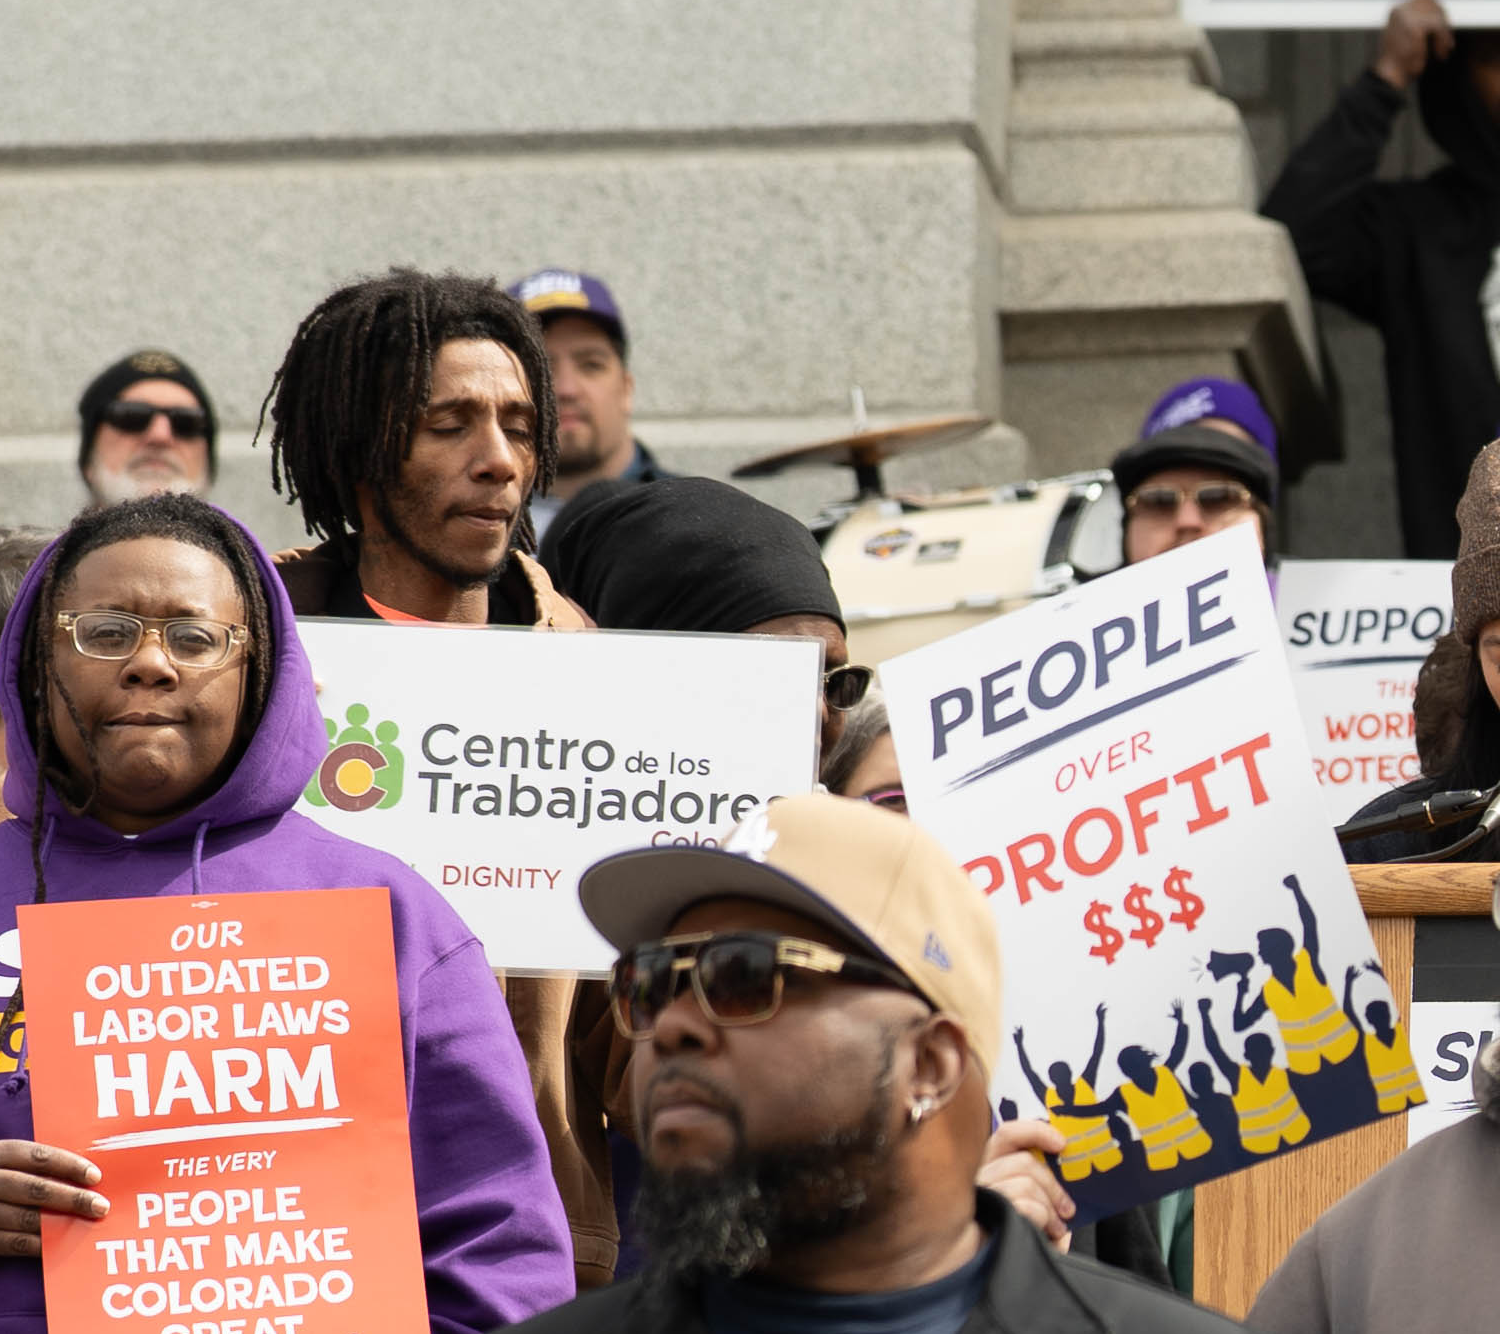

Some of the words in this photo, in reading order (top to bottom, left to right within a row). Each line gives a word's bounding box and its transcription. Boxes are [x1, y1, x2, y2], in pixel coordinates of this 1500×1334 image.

[1288, 606, 1455, 647] SUPPO
[931, 570, 1237, 760] PEOPLE
[419, 723, 615, 773] Centro
[625, 749, 657, 774] de
[669, 749, 711, 776] los
[1324, 712, 1415, 742] WOR
[1055, 730, 1153, 793] OVER
[418, 771, 788, 827] Trabajadore
[443, 865, 562, 890] DIGNITY
[171, 919, 244, 953] OUR
[1083, 867, 1206, 964] $$$
[85, 957, 330, 1002] OUTDATED
[72, 1005, 219, 1047] LABOR
[233, 999, 350, 1038] LAWS
[94, 1043, 342, 1119] HARM
[164, 1156, 211, 1180] THE
[214, 1148, 277, 1175] VERY
[136, 1186, 305, 1229] PEOPLE
[97, 1234, 214, 1277] THAT
[224, 1226, 353, 1266] MAKE
[101, 1268, 353, 1320] COLORADO
